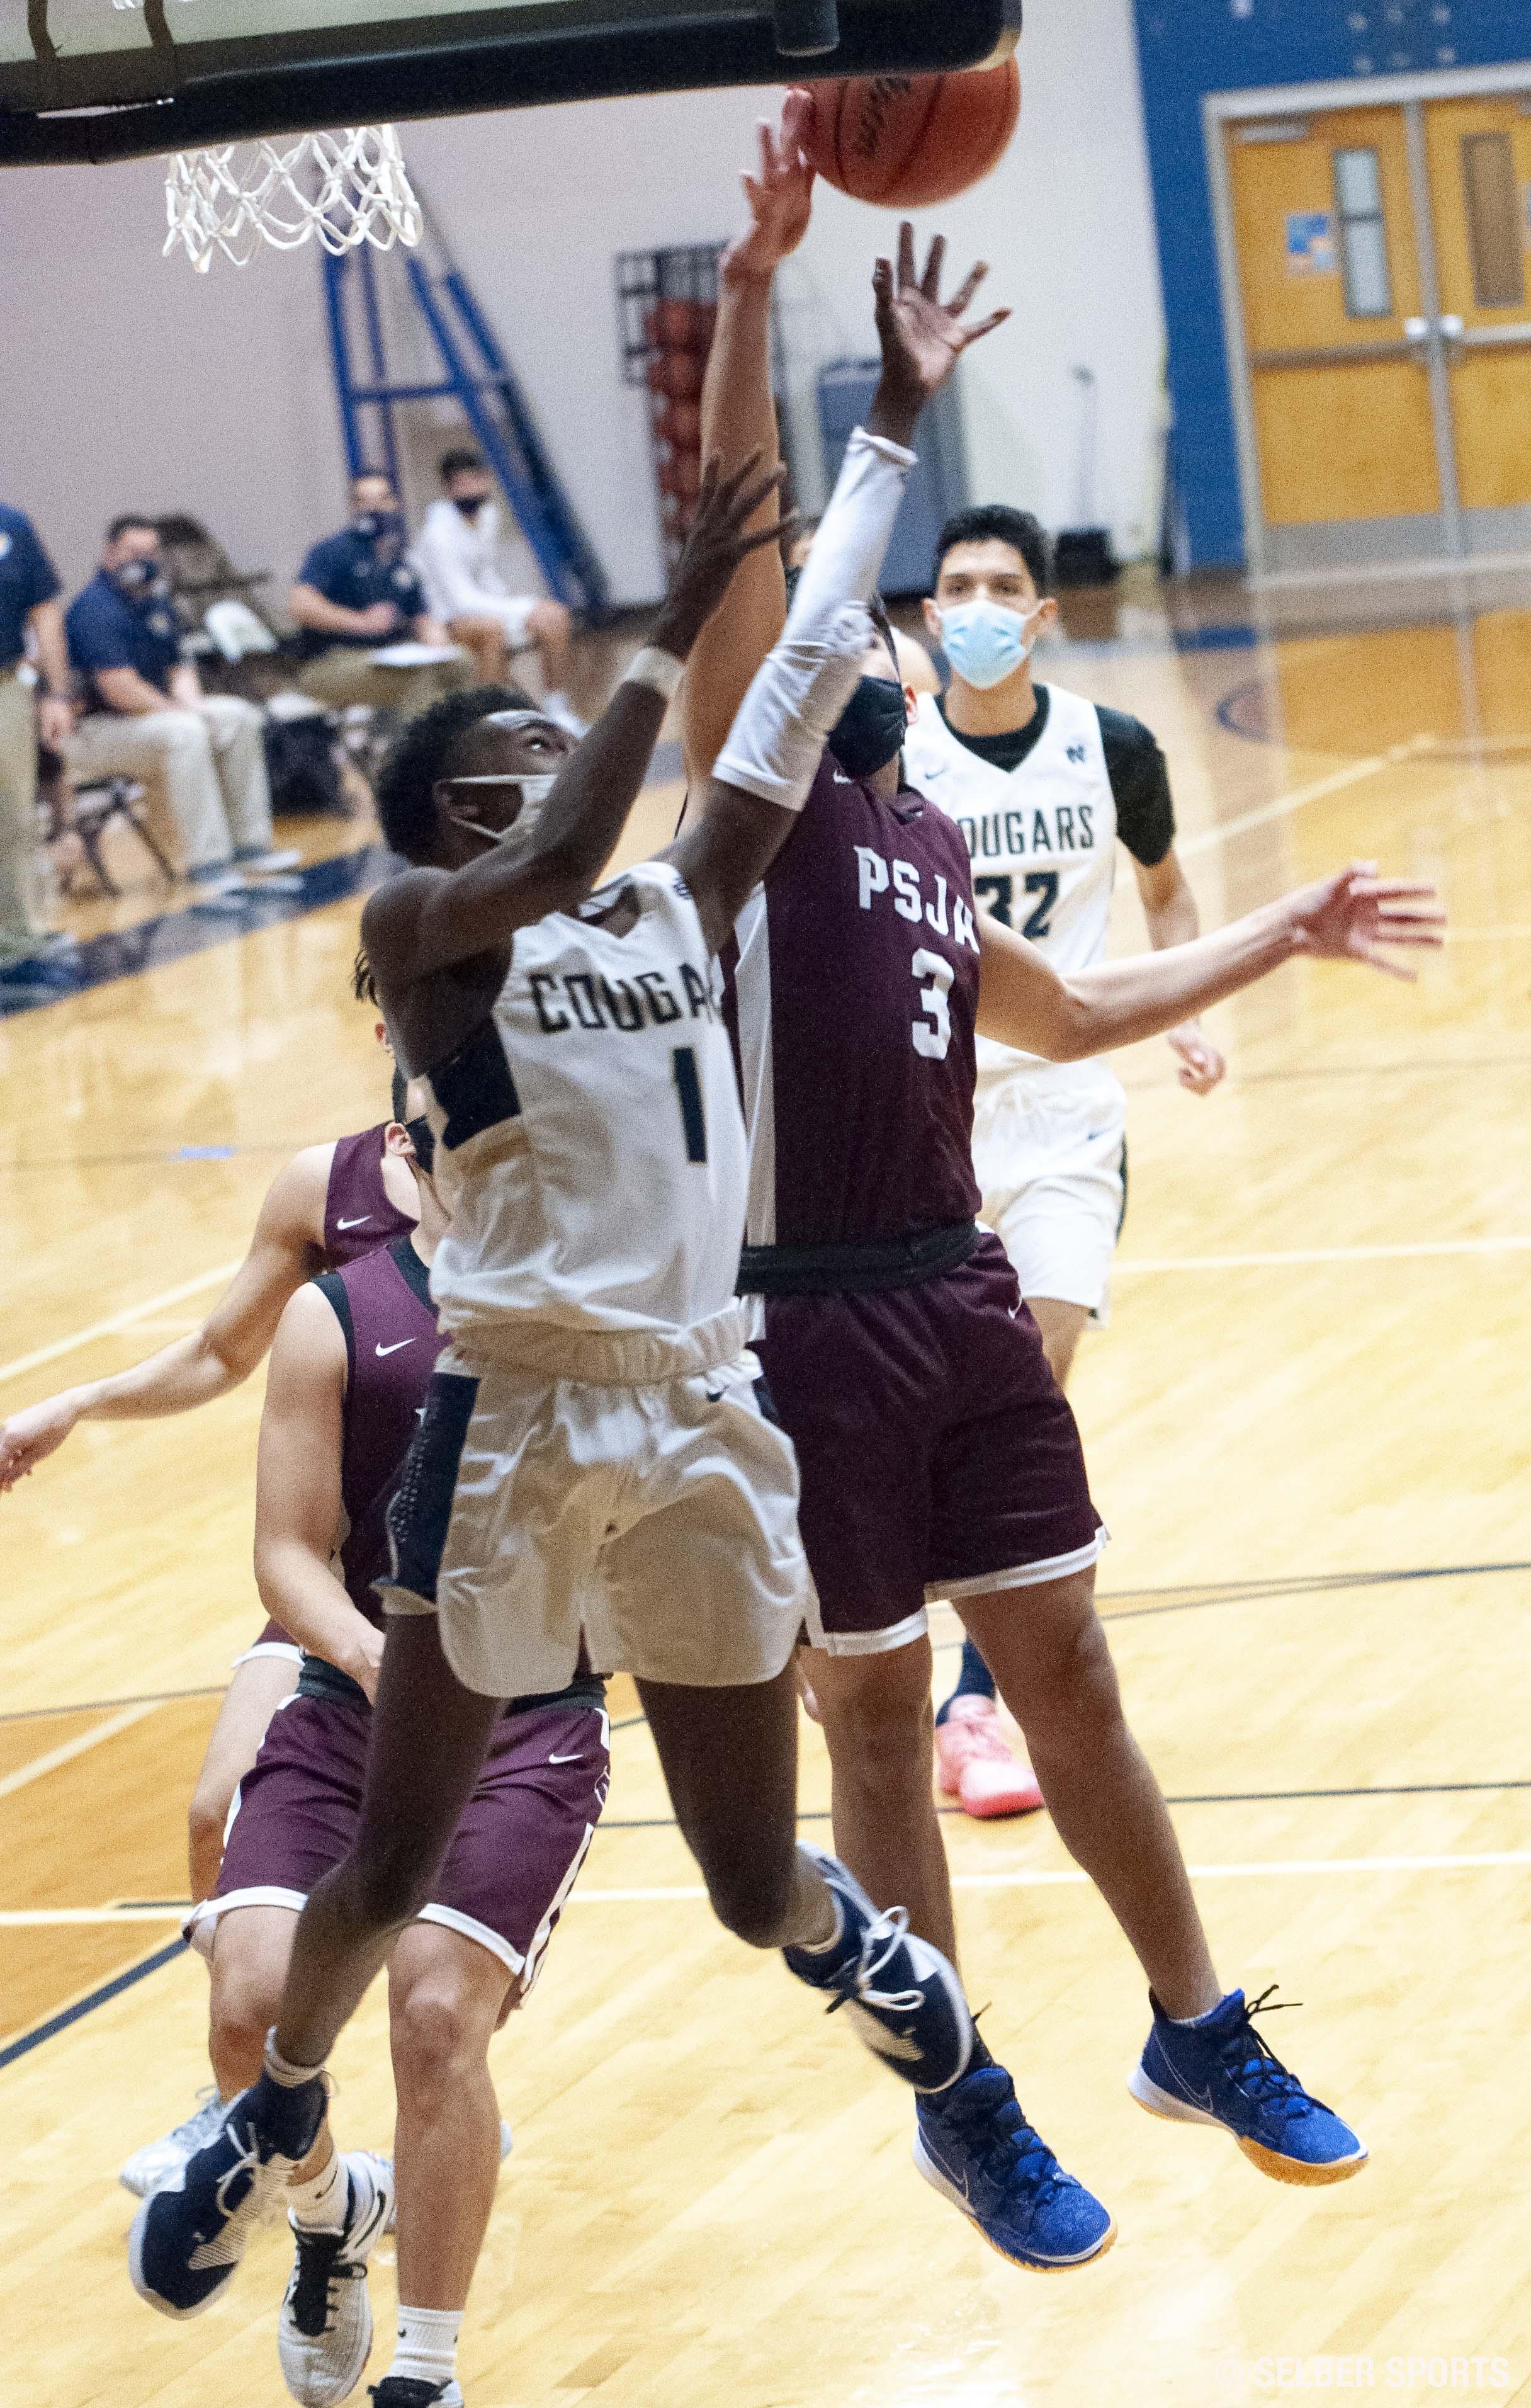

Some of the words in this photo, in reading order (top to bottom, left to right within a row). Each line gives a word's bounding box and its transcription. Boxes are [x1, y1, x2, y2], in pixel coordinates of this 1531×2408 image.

[957, 804, 1094, 858] OUGARS
[853, 846, 980, 955] PSJA
[974, 870, 1059, 940] 32
[529, 962, 715, 1033] COUGA
[912, 948, 954, 1060] 3
[671, 1045, 708, 1164] 1
